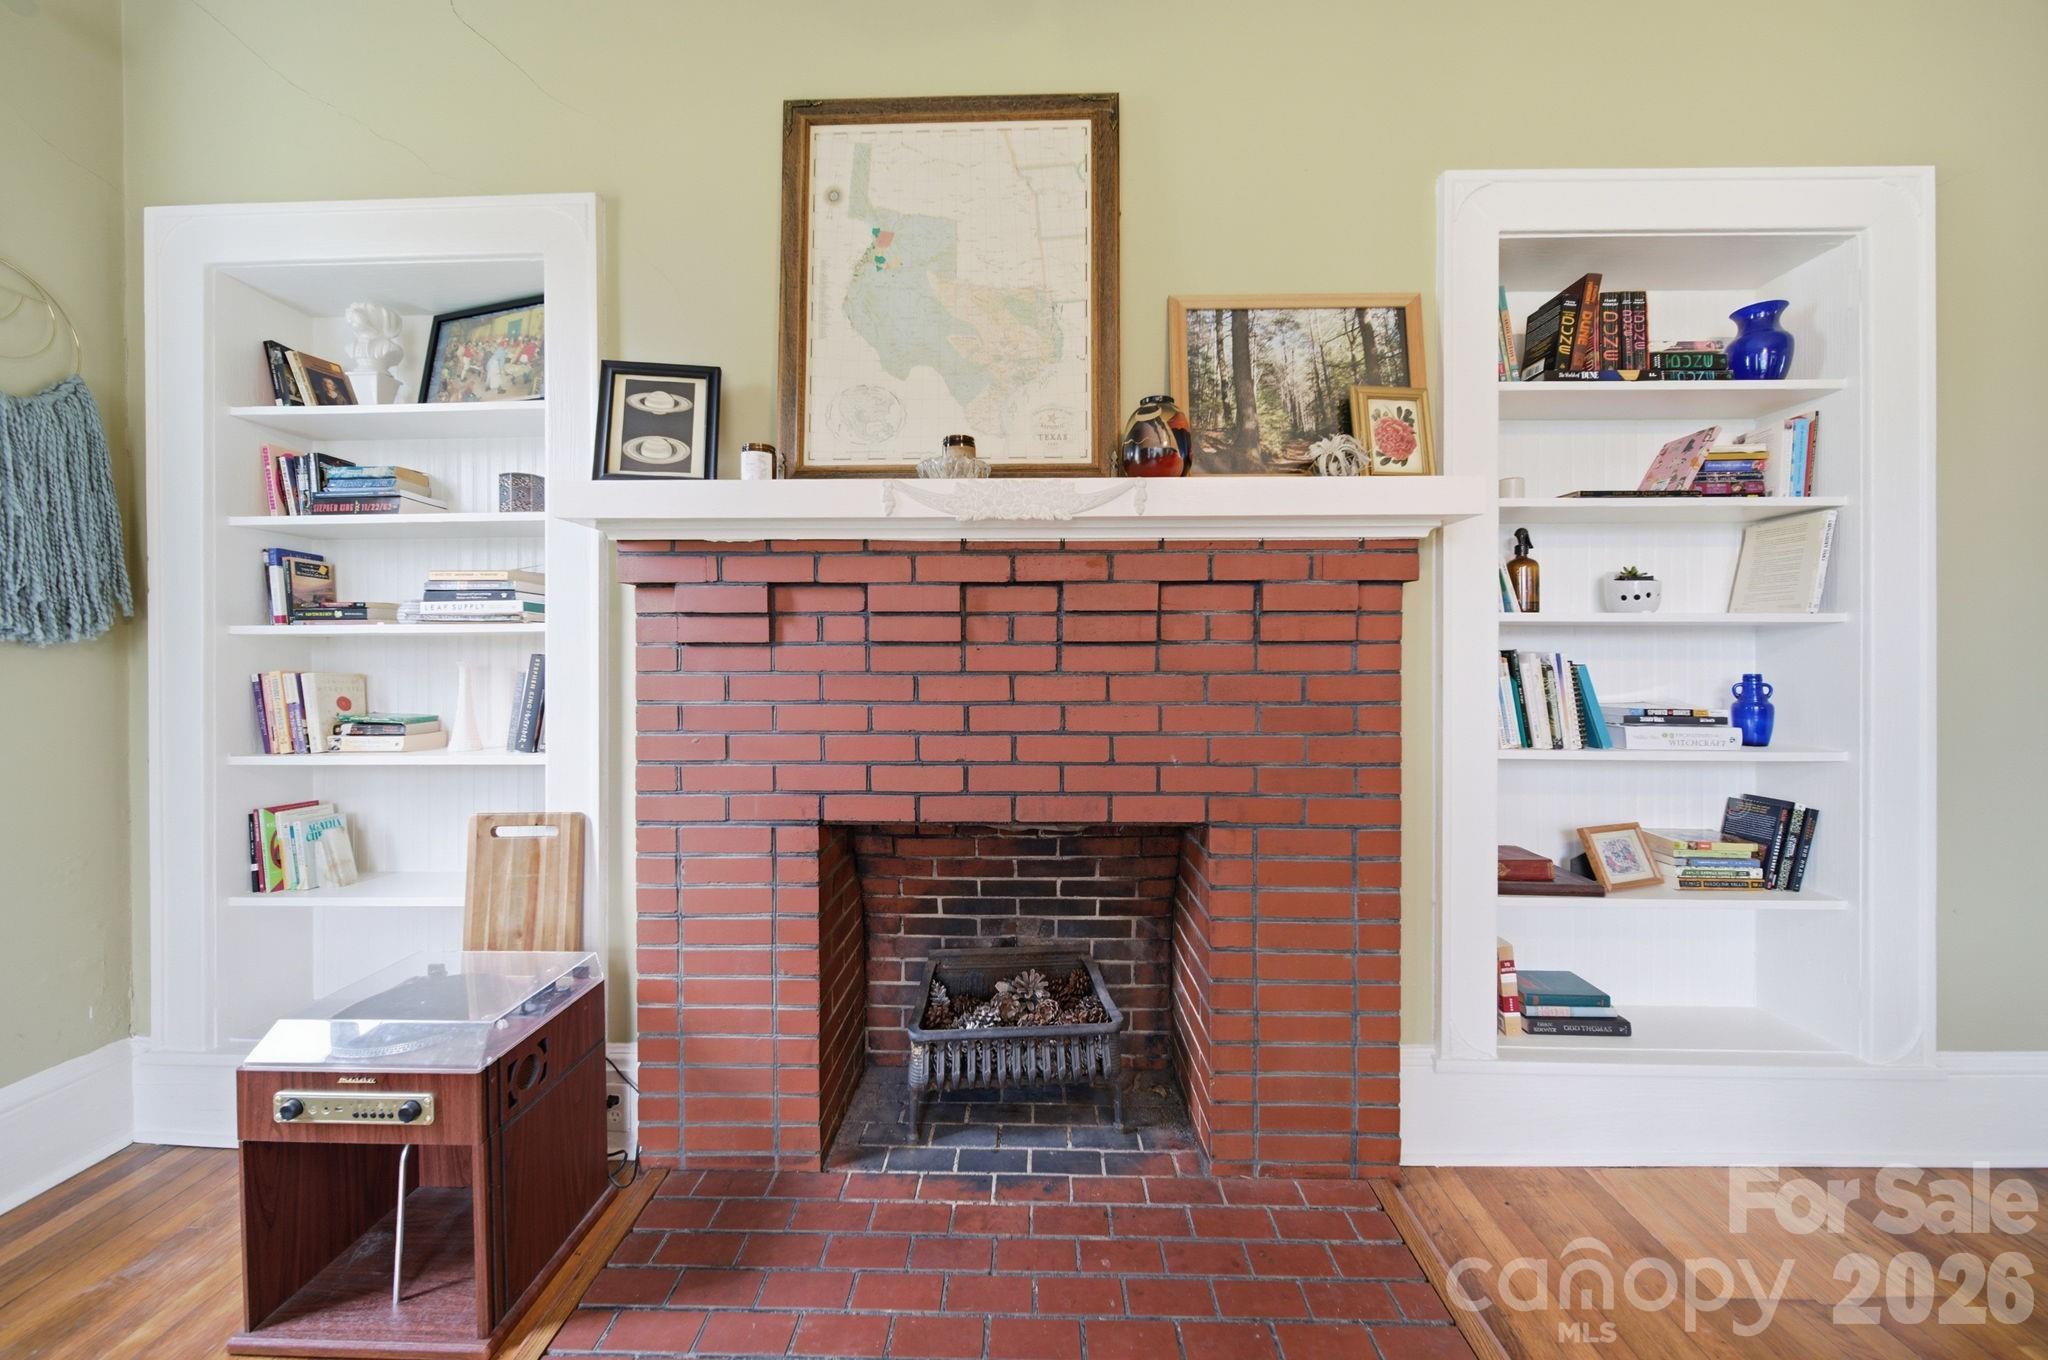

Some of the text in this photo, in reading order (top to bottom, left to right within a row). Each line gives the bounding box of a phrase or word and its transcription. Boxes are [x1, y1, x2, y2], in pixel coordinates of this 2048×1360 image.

[1578, 309, 1594, 346] DUNE
[1581, 370, 1600, 380] DUNE
[1038, 433, 1068, 441] TEXAS
[340, 503, 354, 512] KING
[424, 603, 449, 611] LEAF
[526, 658, 541, 710] STEPHEN KING
[1668, 739, 1727, 749] WITCHCRAFT
[1580, 1025, 1613, 1033] THOMAS
